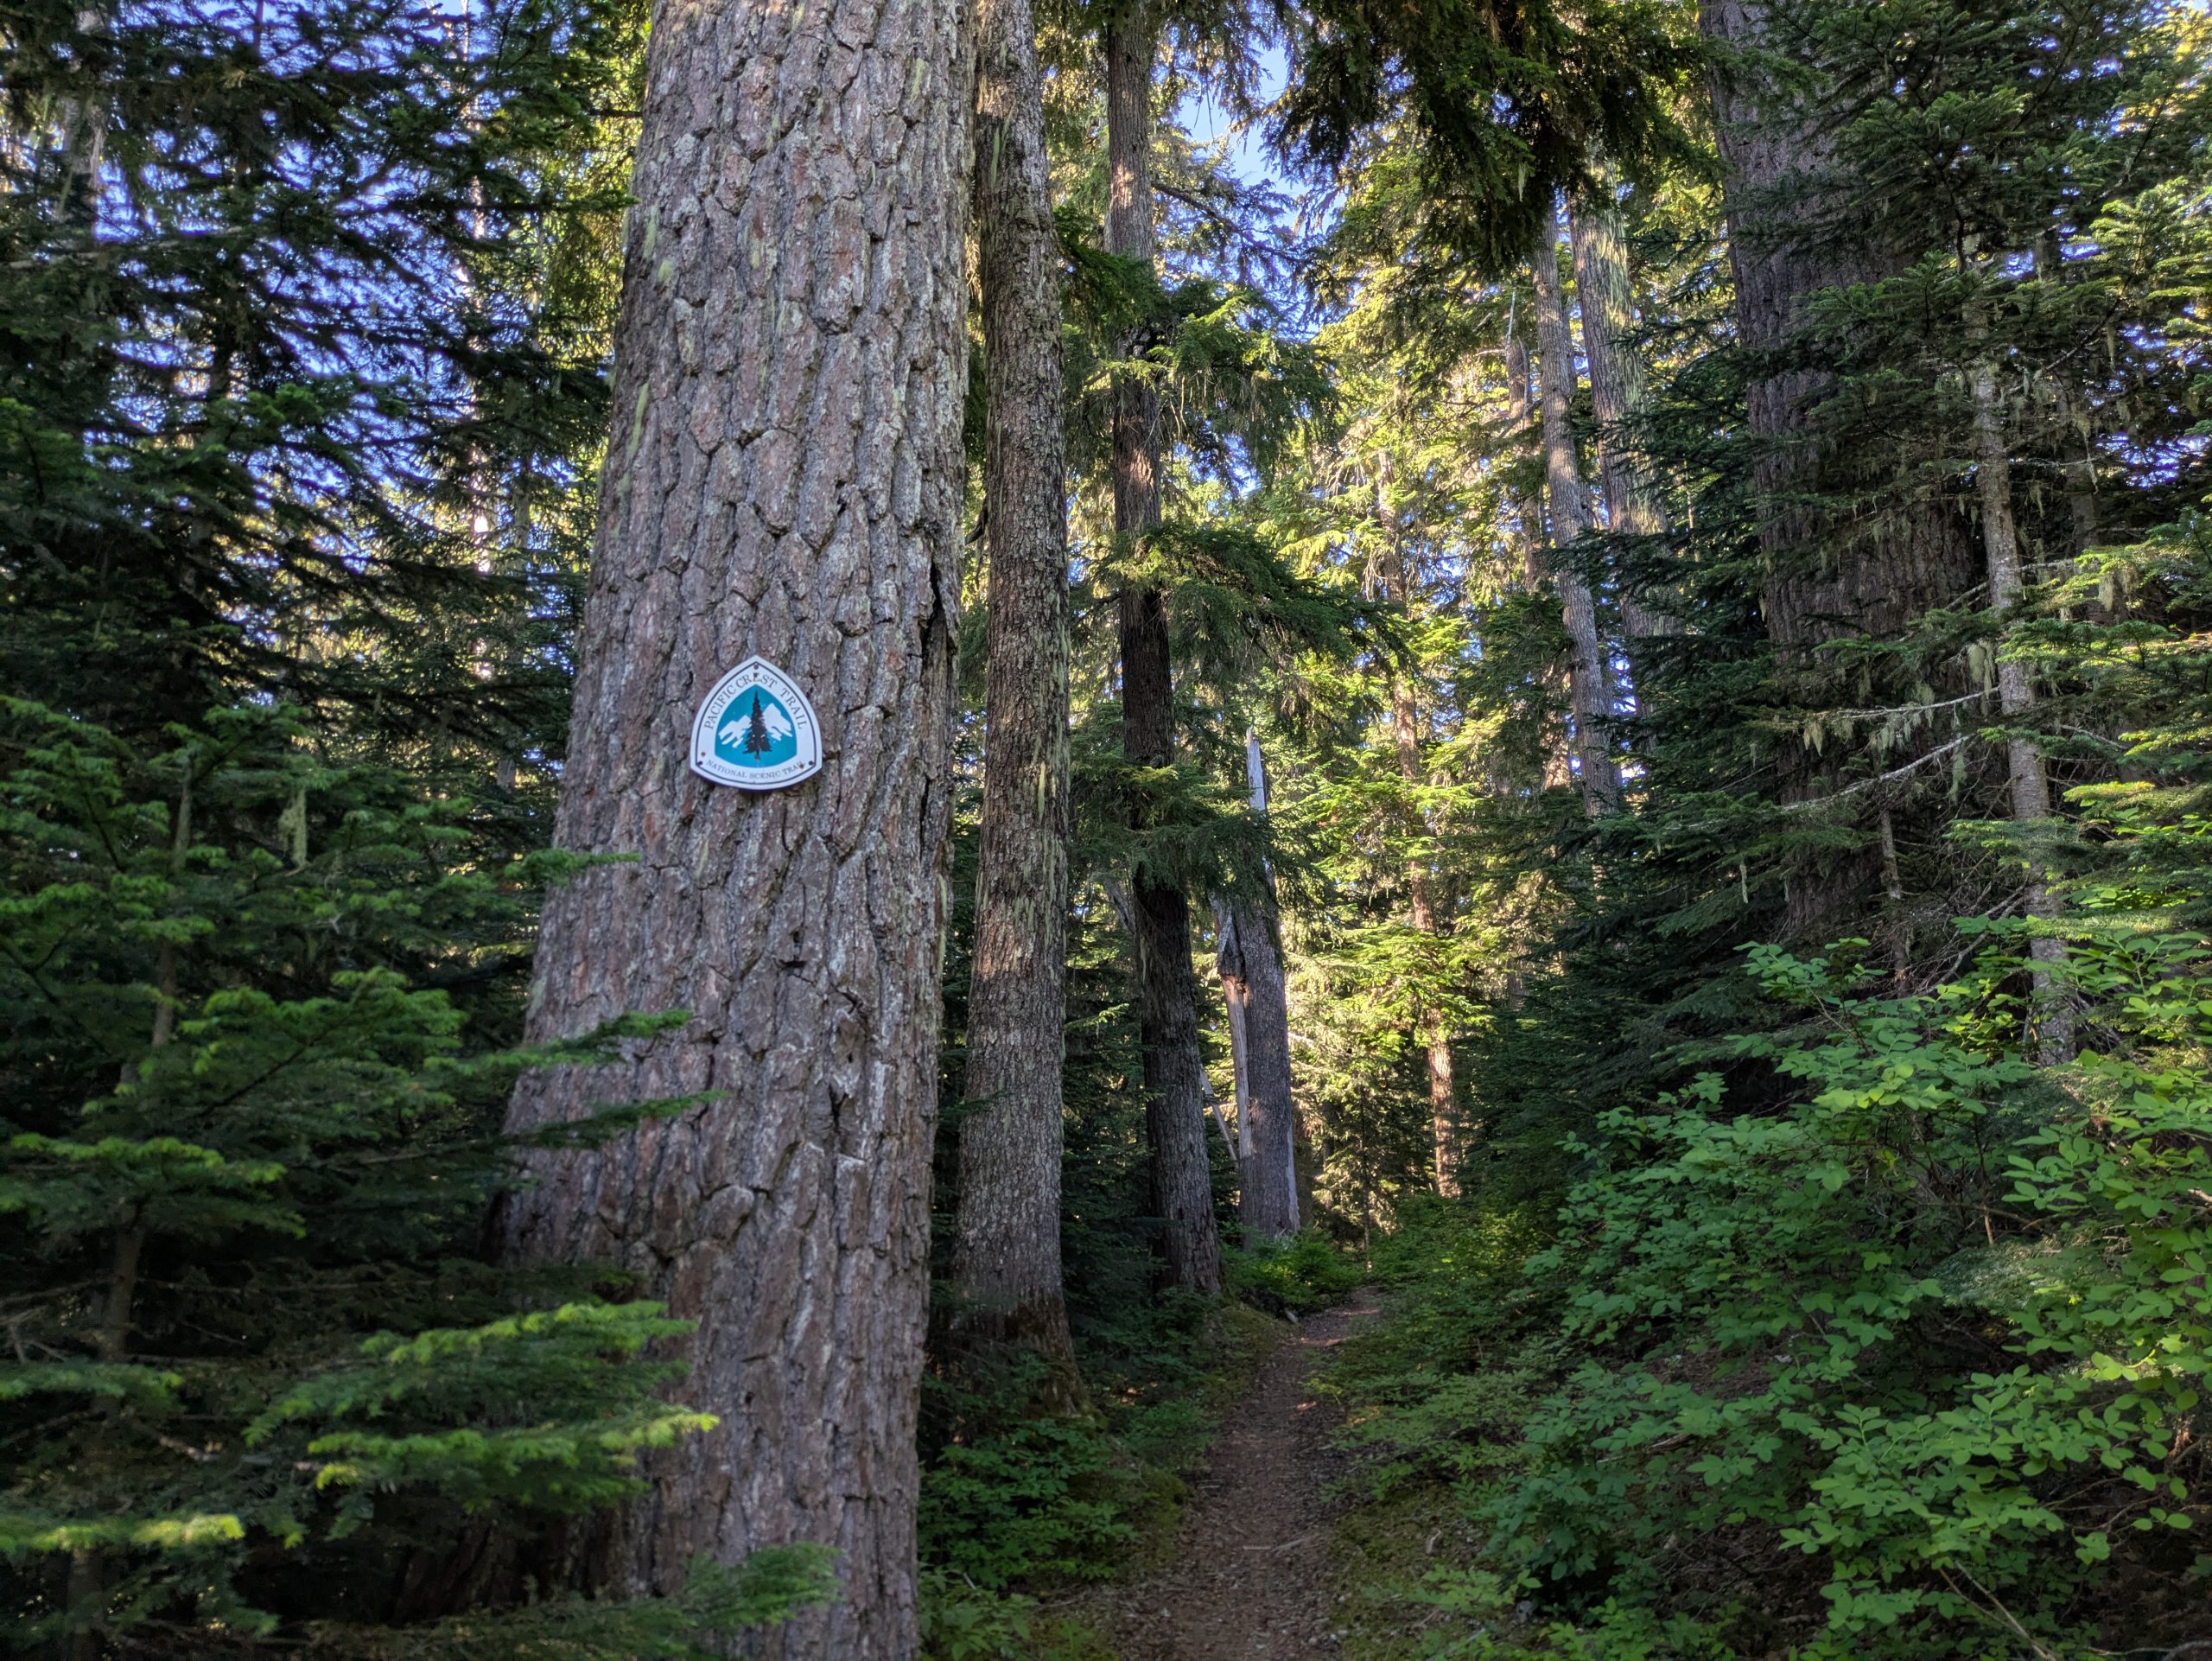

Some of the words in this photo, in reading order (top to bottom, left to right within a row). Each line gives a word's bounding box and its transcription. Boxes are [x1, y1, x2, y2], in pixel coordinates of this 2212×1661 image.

[704, 684, 734, 729] PACIFIC
[735, 673, 778, 689] CREST
[779, 688, 808, 729] TRAIL
[706, 760, 747, 778] NATIONAL
